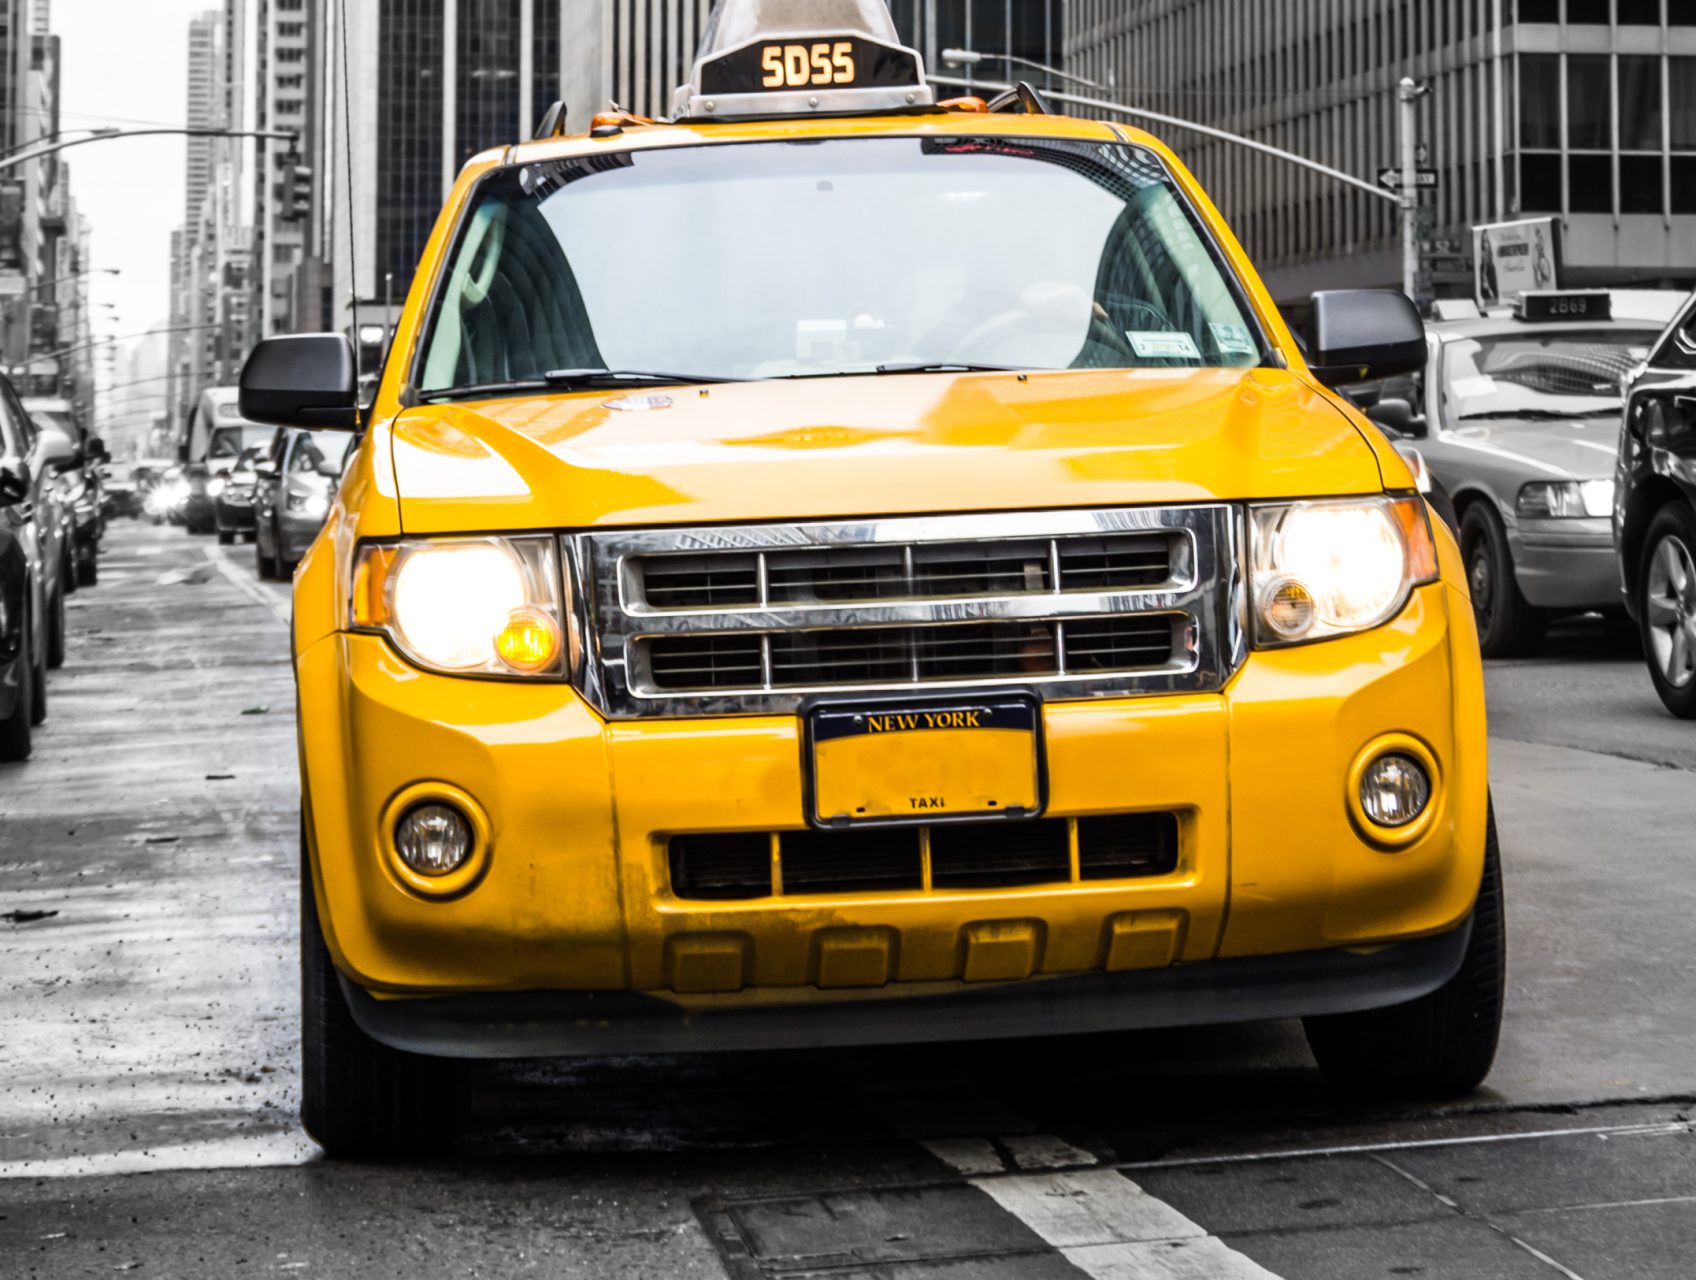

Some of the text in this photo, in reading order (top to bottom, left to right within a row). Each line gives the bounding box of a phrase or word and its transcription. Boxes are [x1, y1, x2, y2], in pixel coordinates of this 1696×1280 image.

[867, 711, 981, 732] NEW YORK
[909, 797, 945, 809] TAXI
